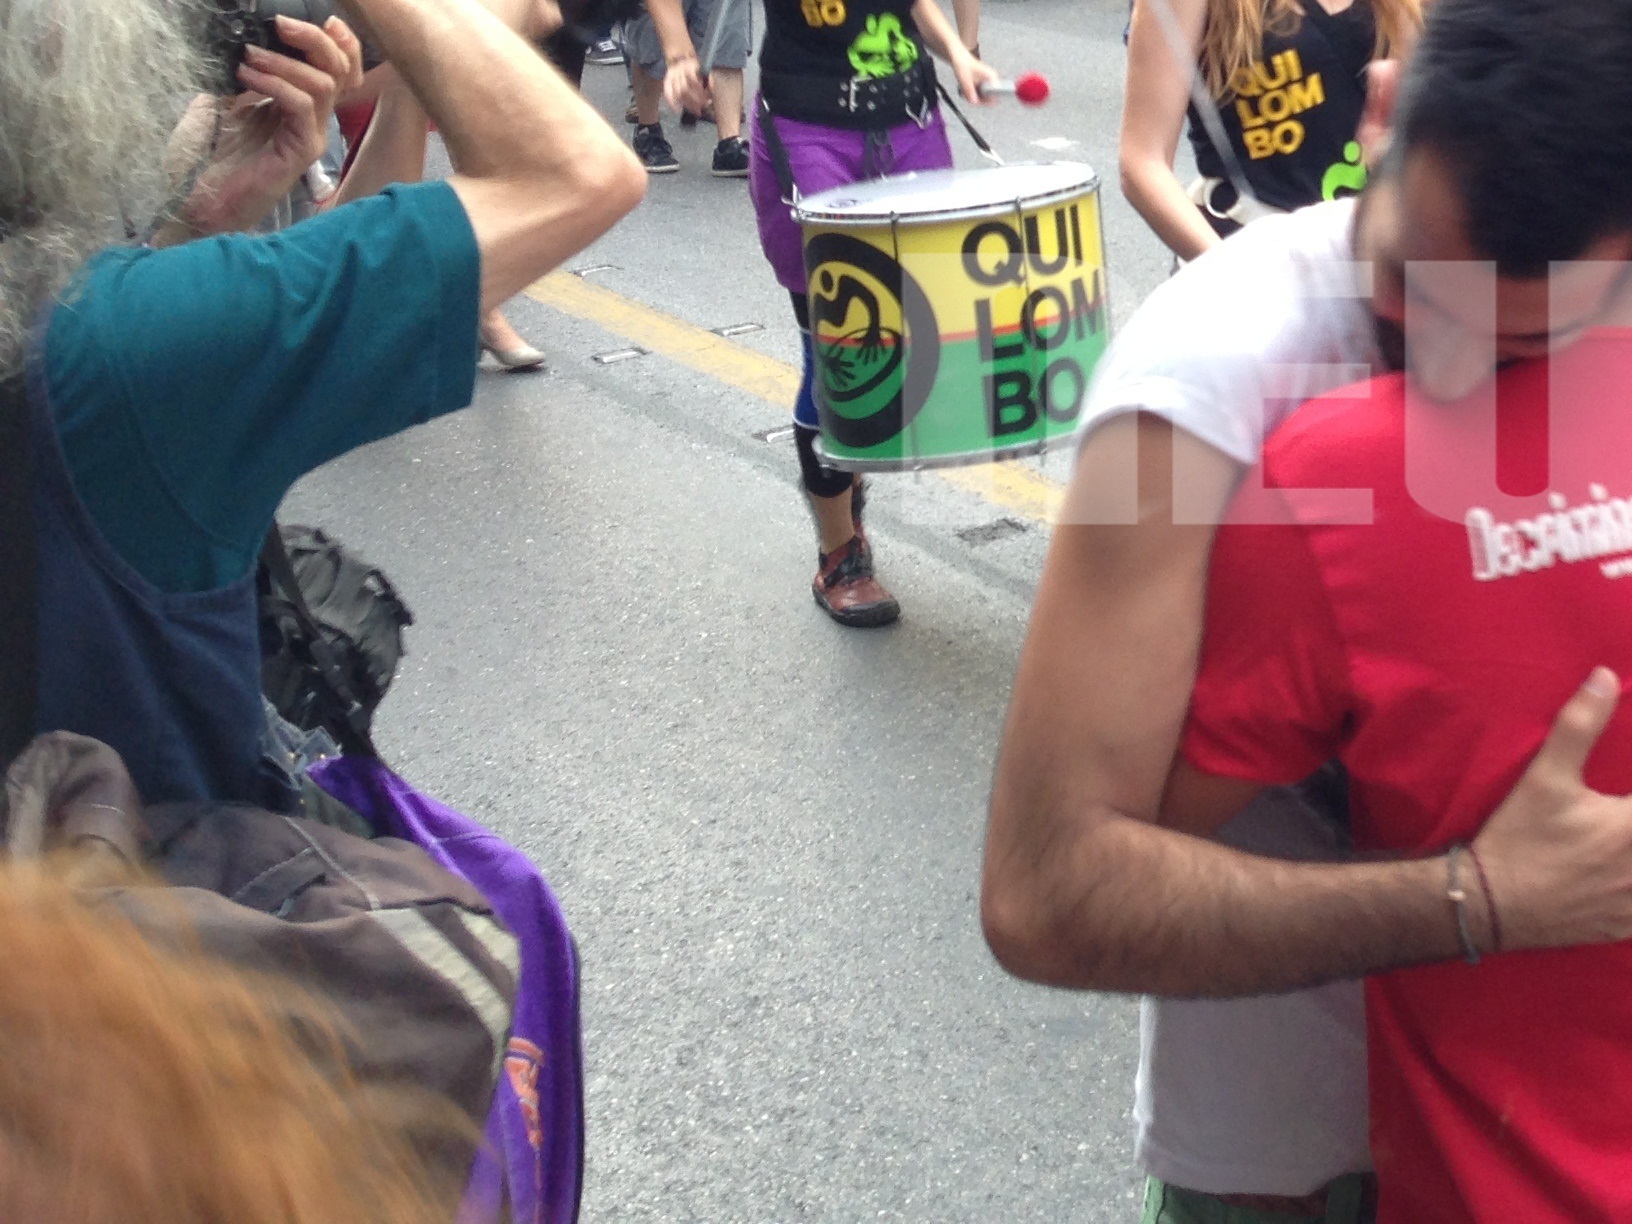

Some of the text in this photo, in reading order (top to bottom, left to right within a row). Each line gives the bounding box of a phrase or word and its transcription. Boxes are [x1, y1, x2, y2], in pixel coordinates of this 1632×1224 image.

[1235, 72, 1326, 128] LOM
[1242, 119, 1305, 160] BO
[961, 203, 1083, 287] QUI
[974, 269, 1108, 364] LOM
[983, 356, 1085, 439] BO
